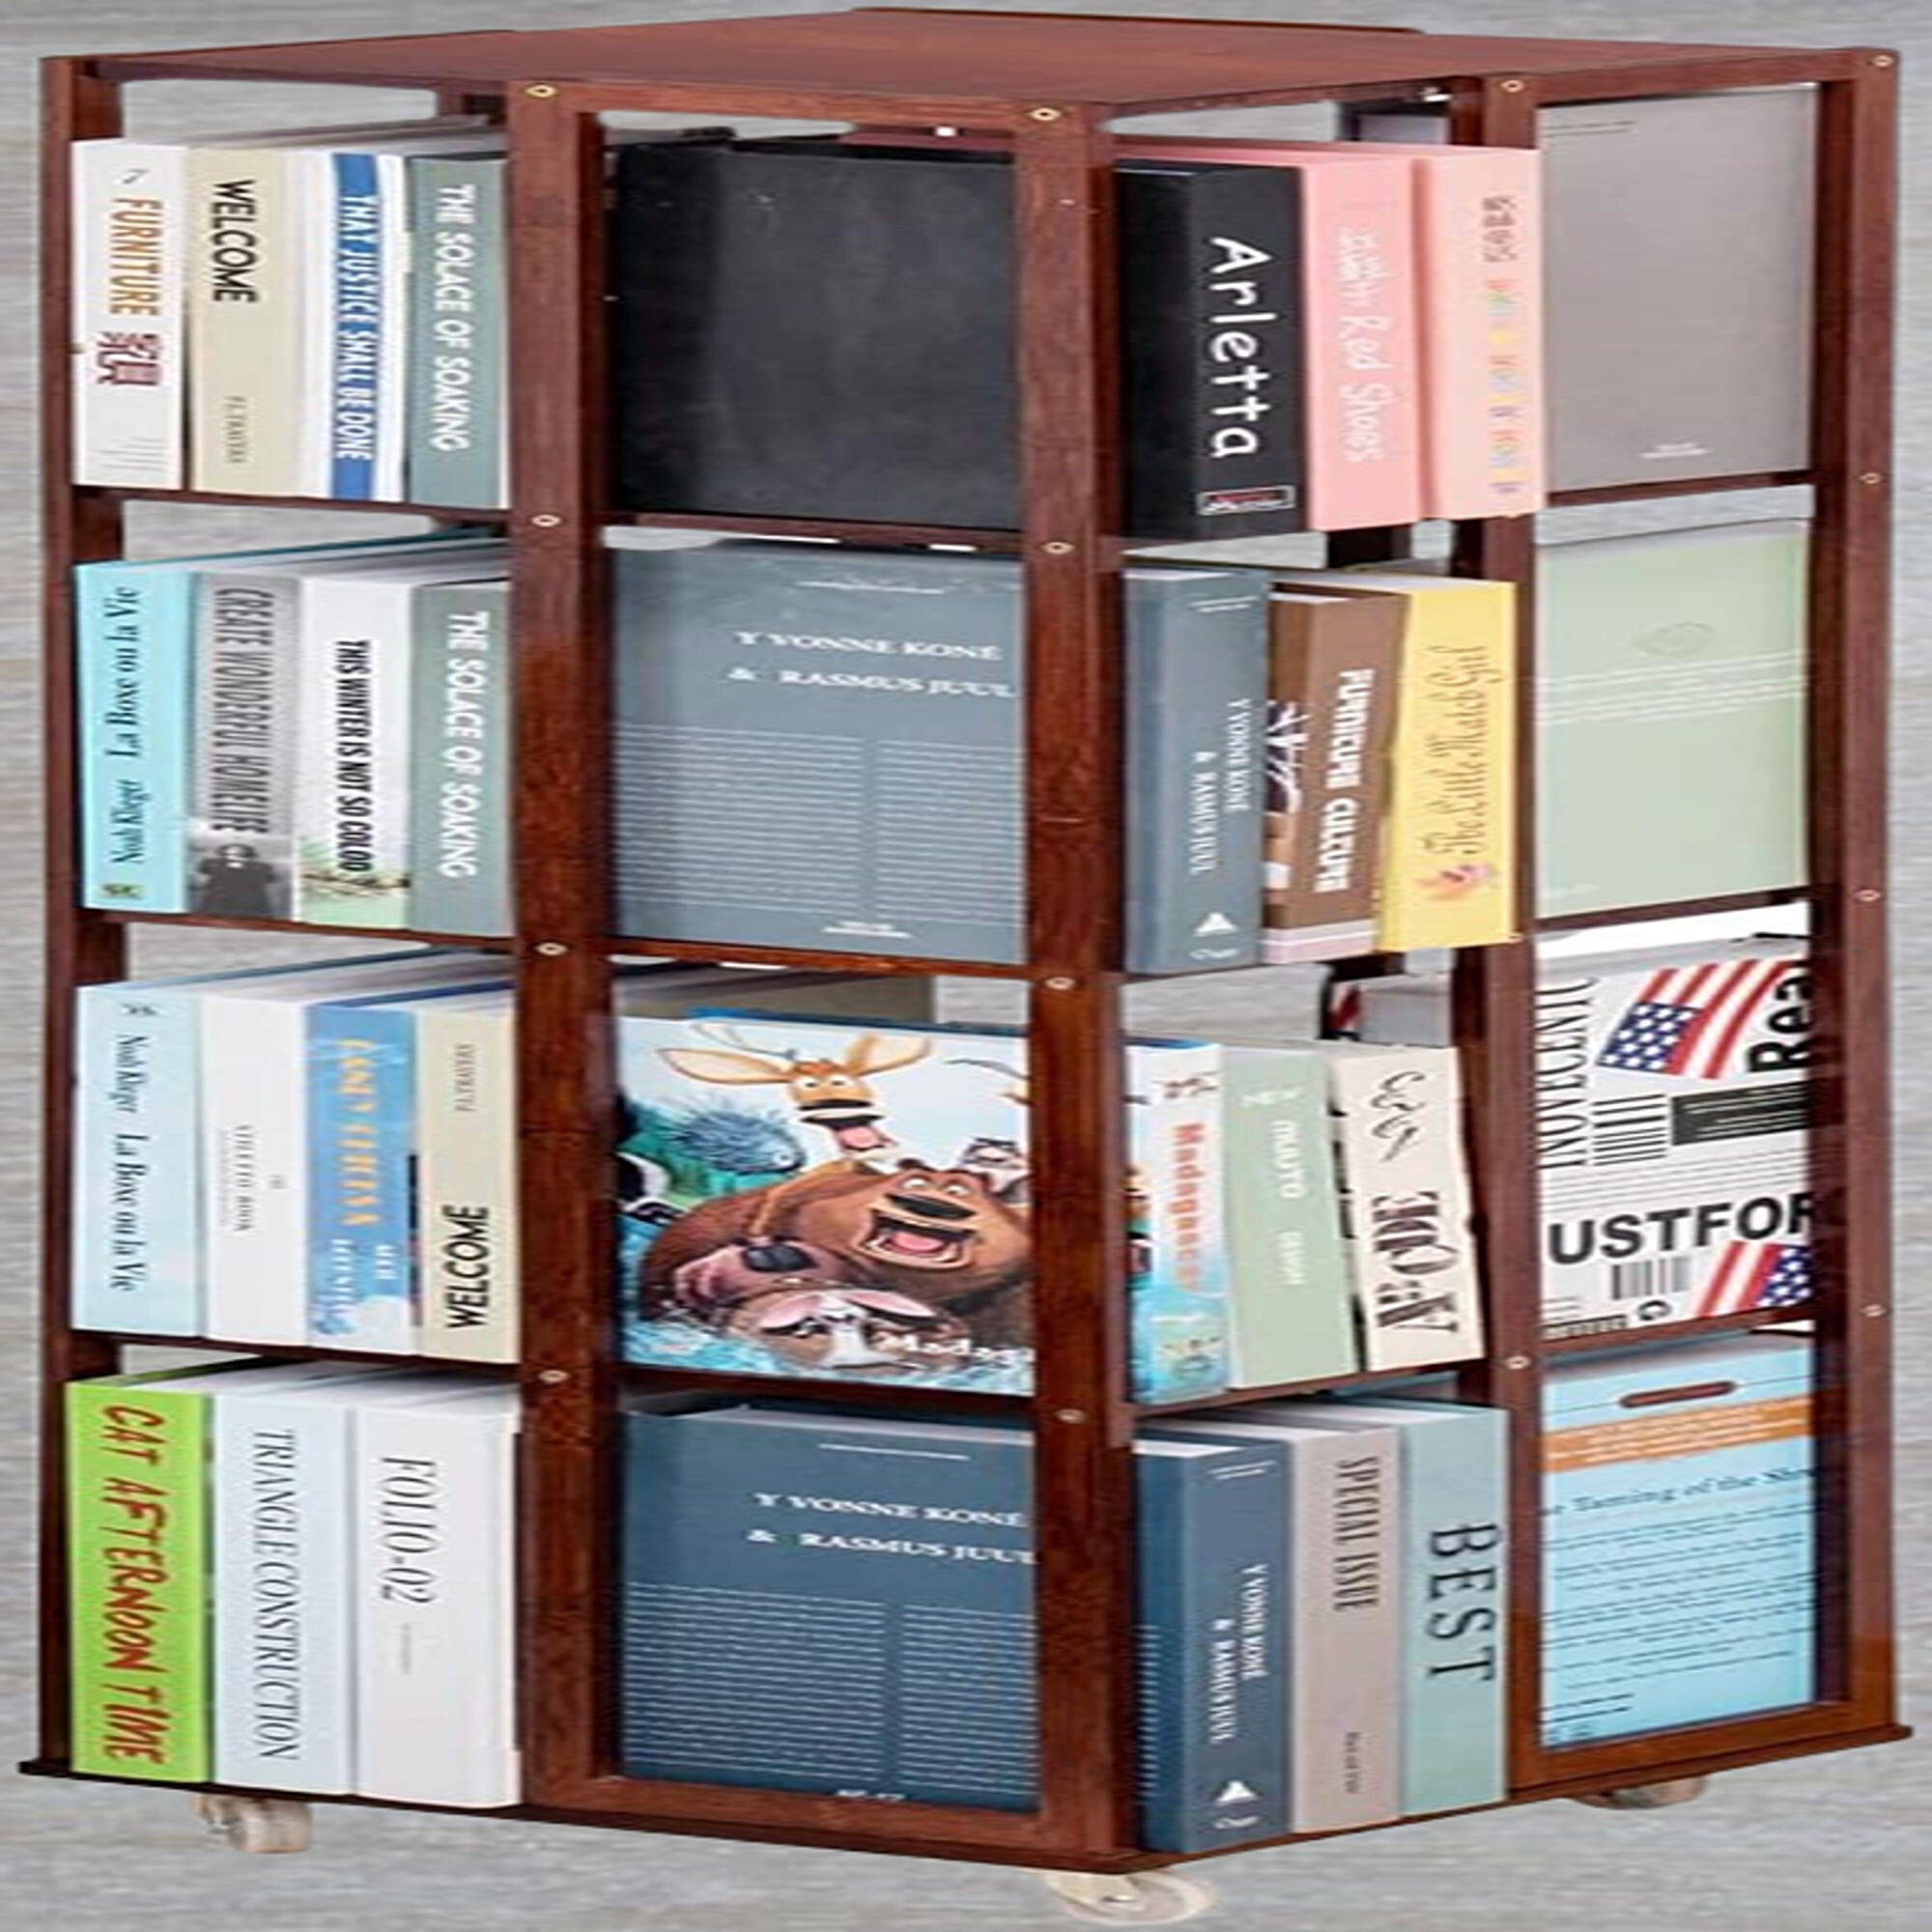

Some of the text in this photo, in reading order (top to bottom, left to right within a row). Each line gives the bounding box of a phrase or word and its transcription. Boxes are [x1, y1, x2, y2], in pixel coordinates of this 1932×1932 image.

[107, 197, 162, 317] FURNITURE
[209, 179, 259, 303] WELCOME
[336, 249, 381, 324] JUSTICE
[335, 329, 378, 383] SHALL
[428, 183, 476, 452] THE SOLACE OF SOAKING
[1208, 235, 1278, 459] Arletta
[1338, 314, 1398, 372] Red
[334, 411, 374, 462] DONE
[335, 386, 375, 409] BE
[1338, 382, 1395, 464] Shoes
[103, 585, 142, 761] La Boxe ou la Vie
[210, 586, 274, 835] CREATE WONDERFUL HOMELIFE
[334, 639, 374, 676] THIS
[334, 678, 374, 738] WINTER
[726, 666, 756, 682] &
[777, 668, 925, 696] RASMUS
[334, 740, 374, 758] IS
[334, 760, 374, 792] NOT
[436, 610, 491, 879] THE SOLACE OF SOAKING
[1420, 643, 1504, 855] The Little Match Girl
[334, 796, 374, 818] SO
[1747, 959, 1811, 1073] Rea
[109, 1132, 151, 1293] La Boxe ou la Vie
[440, 1204, 491, 1330] WELCOME
[1166, 1122, 1206, 1292] Madagascar
[98, 1404, 173, 1767] CAT AFTERNOON TIME
[380, 1456, 439, 1605] FOLIO-02
[745, 1527, 778, 1545] &
[797, 1530, 948, 1557] RASMUS
[1332, 1456, 1381, 1613] SPECIAL ISSUE
[253, 1429, 300, 1761] TRIANGLE CONSTRUCTION
[1426, 1521, 1501, 1682] BEST
